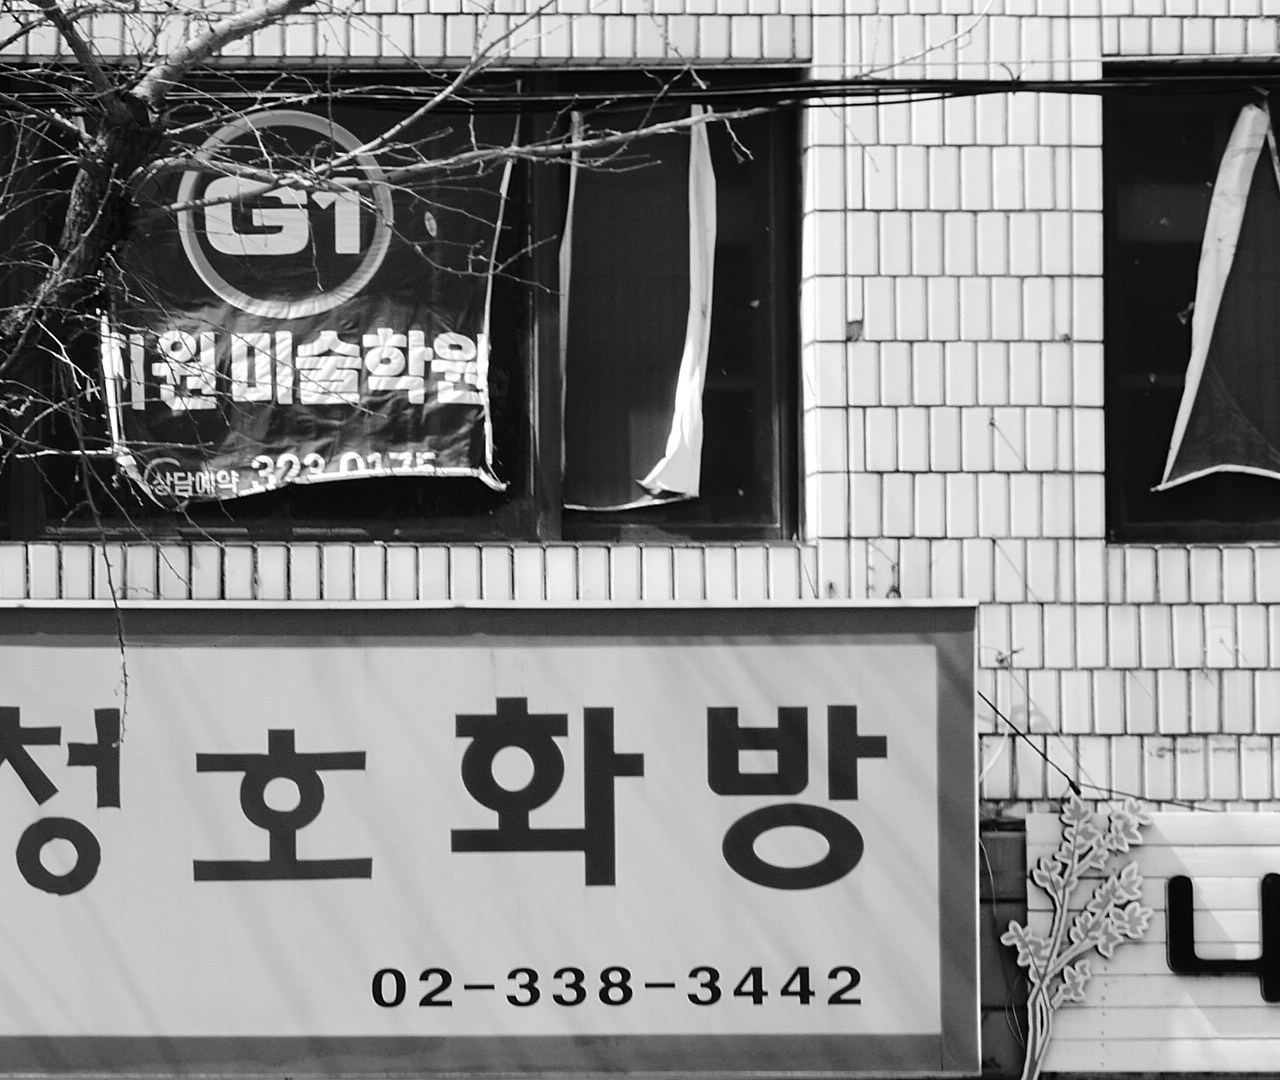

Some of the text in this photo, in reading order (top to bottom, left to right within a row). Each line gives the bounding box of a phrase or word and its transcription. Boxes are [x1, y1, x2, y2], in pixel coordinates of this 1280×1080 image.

[204, 176, 362, 256] G1
[231, 327, 486, 406] 미술학원
[152, 469, 240, 498] 상담예약
[370, 965, 866, 1010] 02-338-3442
